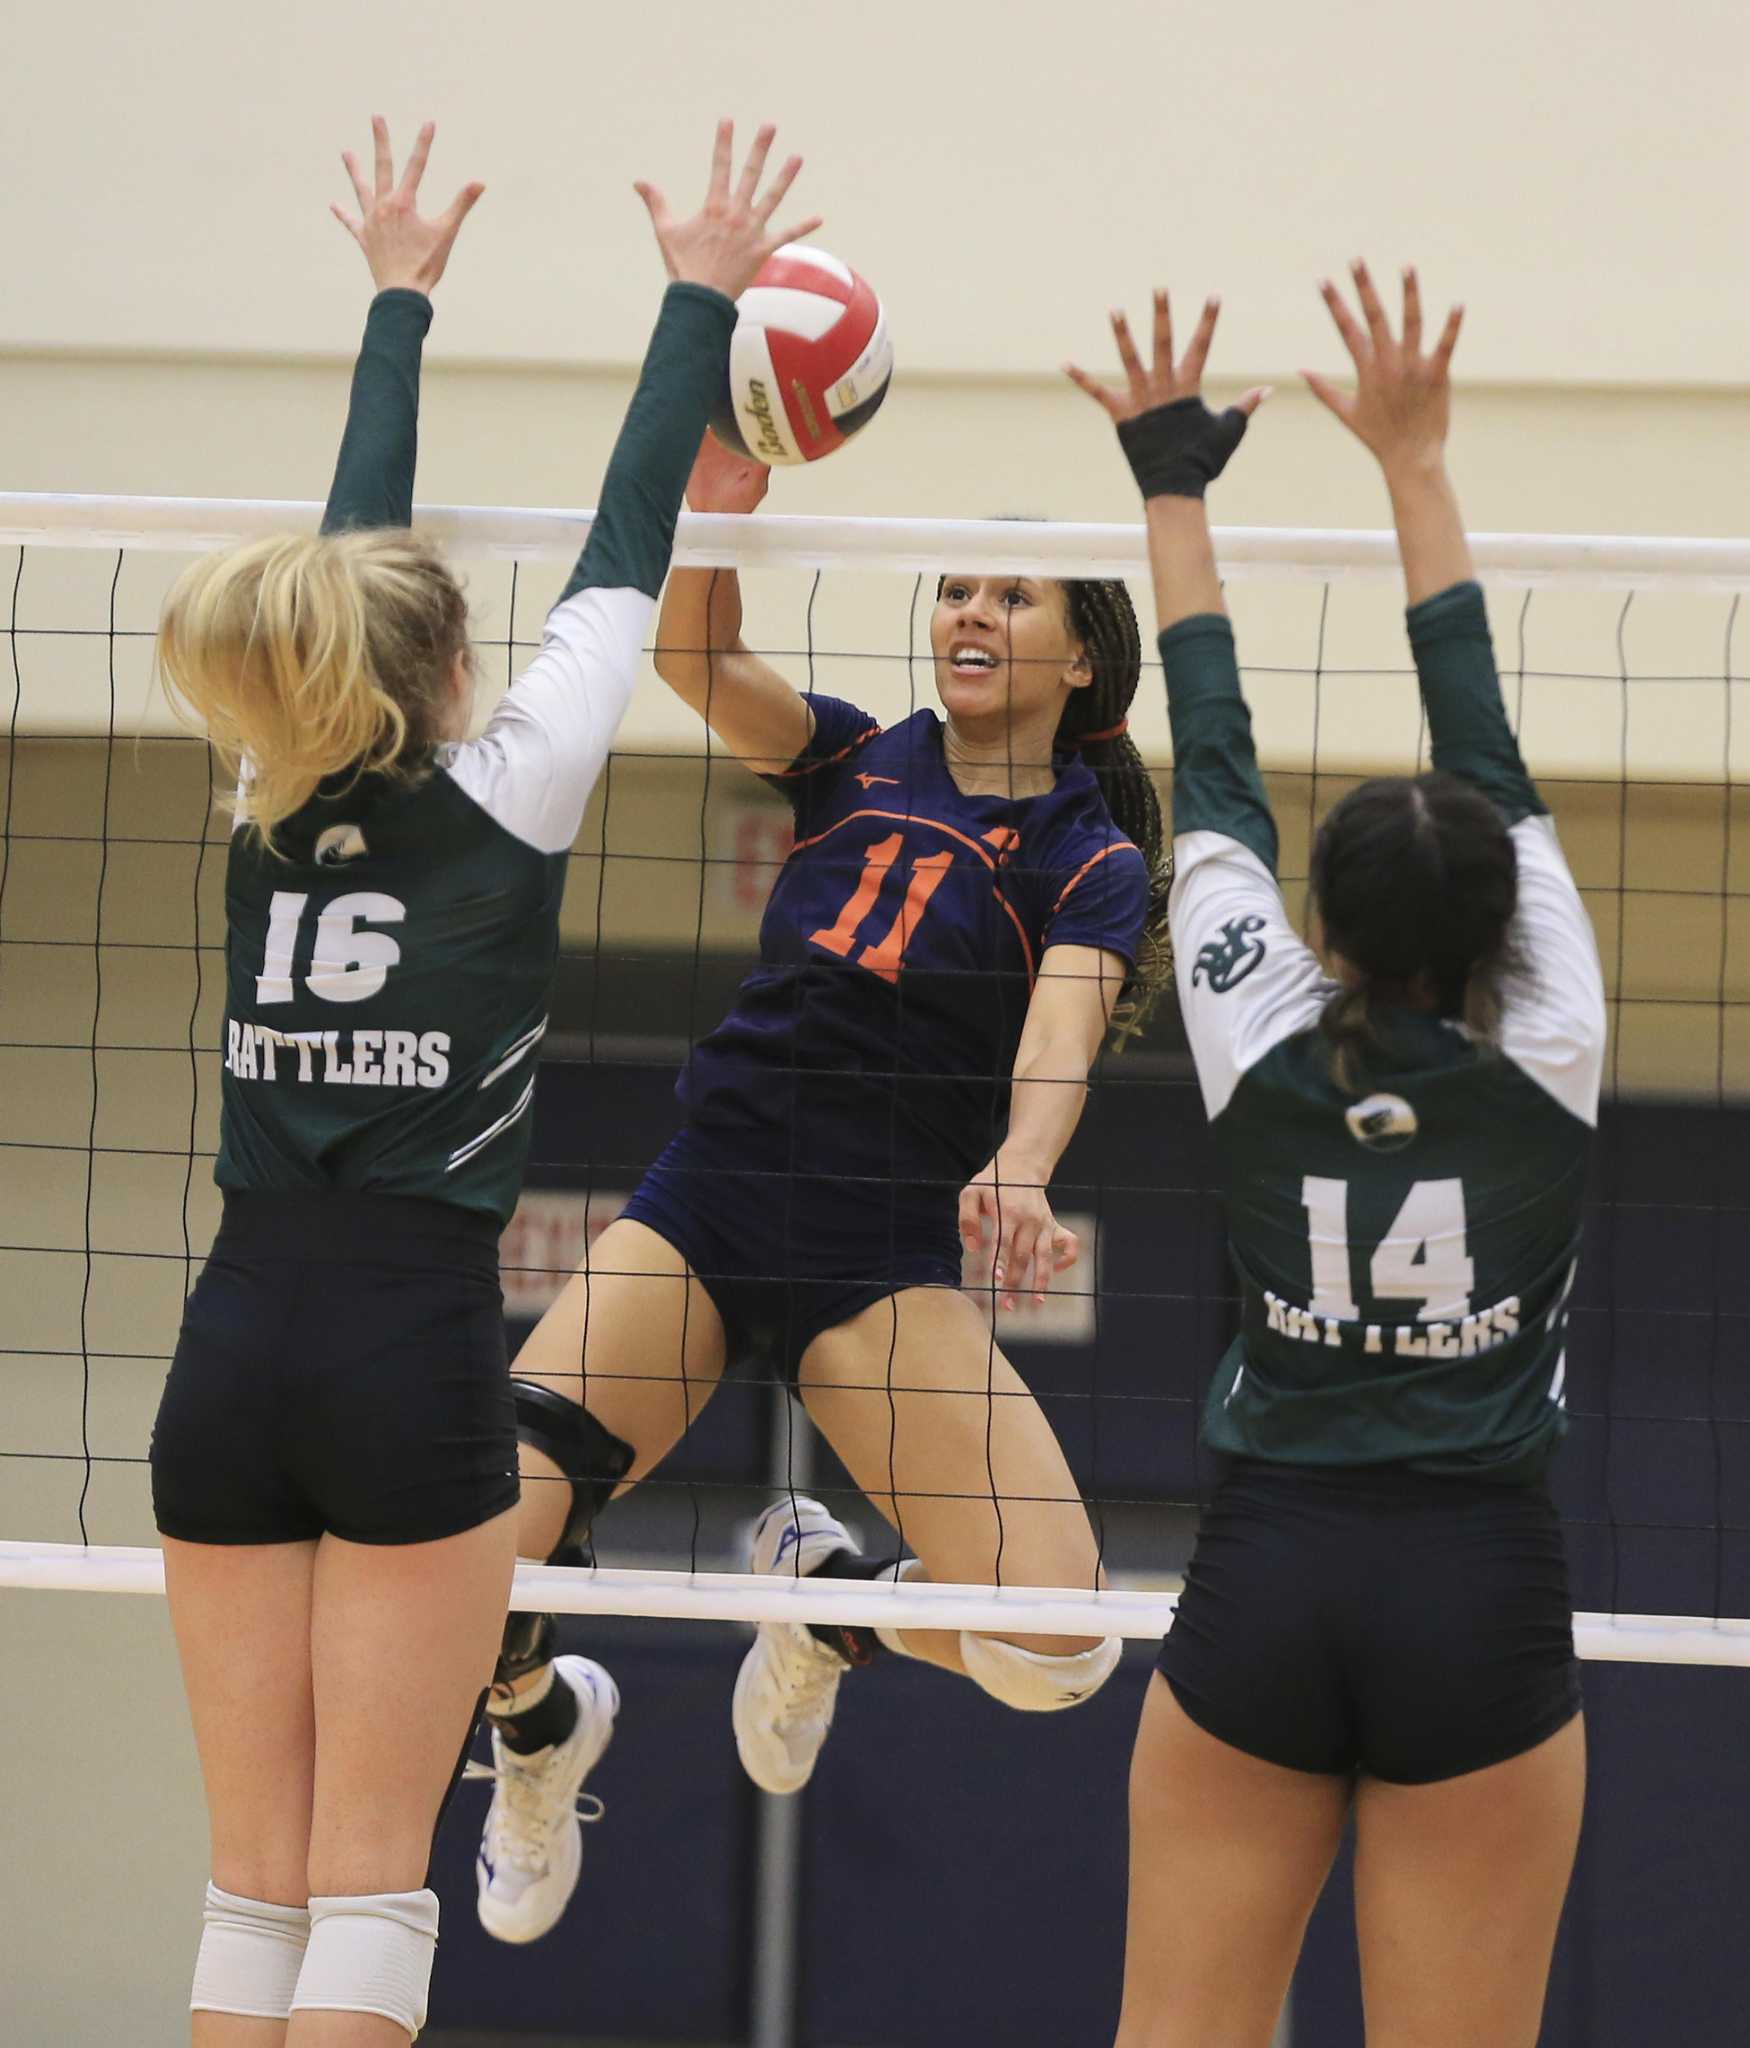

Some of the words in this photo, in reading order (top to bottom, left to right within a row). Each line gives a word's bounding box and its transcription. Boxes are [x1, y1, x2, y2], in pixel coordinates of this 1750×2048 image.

[255, 890, 407, 1005] 16
[808, 832, 955, 985] 11
[225, 1018, 451, 1089] RATTLERS
[1301, 1174, 1475, 1322] 14
